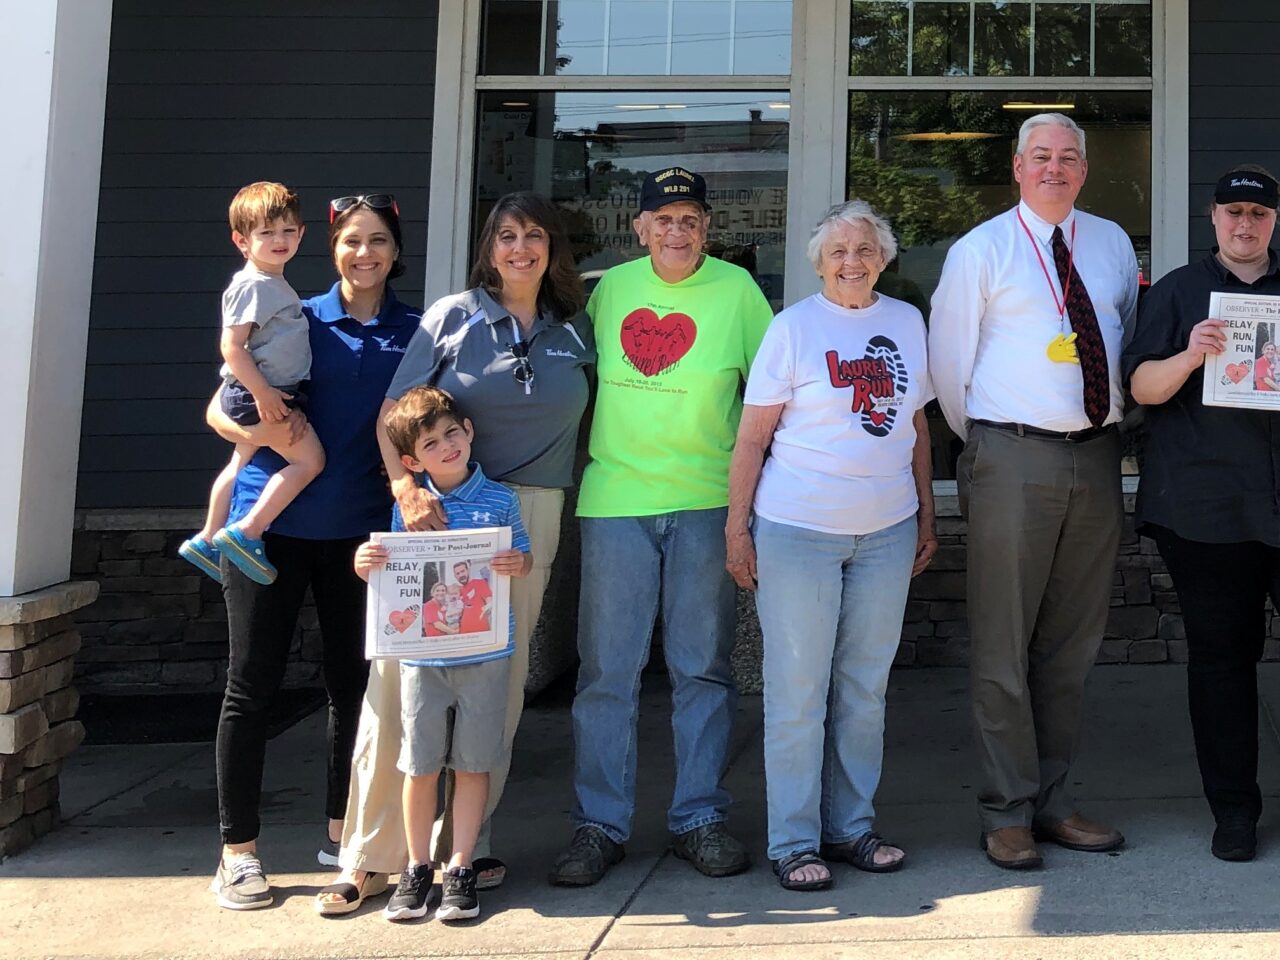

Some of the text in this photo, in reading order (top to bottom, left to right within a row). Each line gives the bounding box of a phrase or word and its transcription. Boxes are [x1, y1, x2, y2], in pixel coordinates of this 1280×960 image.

[664, 185, 678, 193] WLB
[1232, 332, 1255, 342] RUN,
[1235, 344, 1254, 353] FUN
[851, 377, 895, 414] RUN
[385, 562, 421, 572] RELAY,
[396, 575, 421, 585] RUN,
[399, 588, 421, 598] FUN
